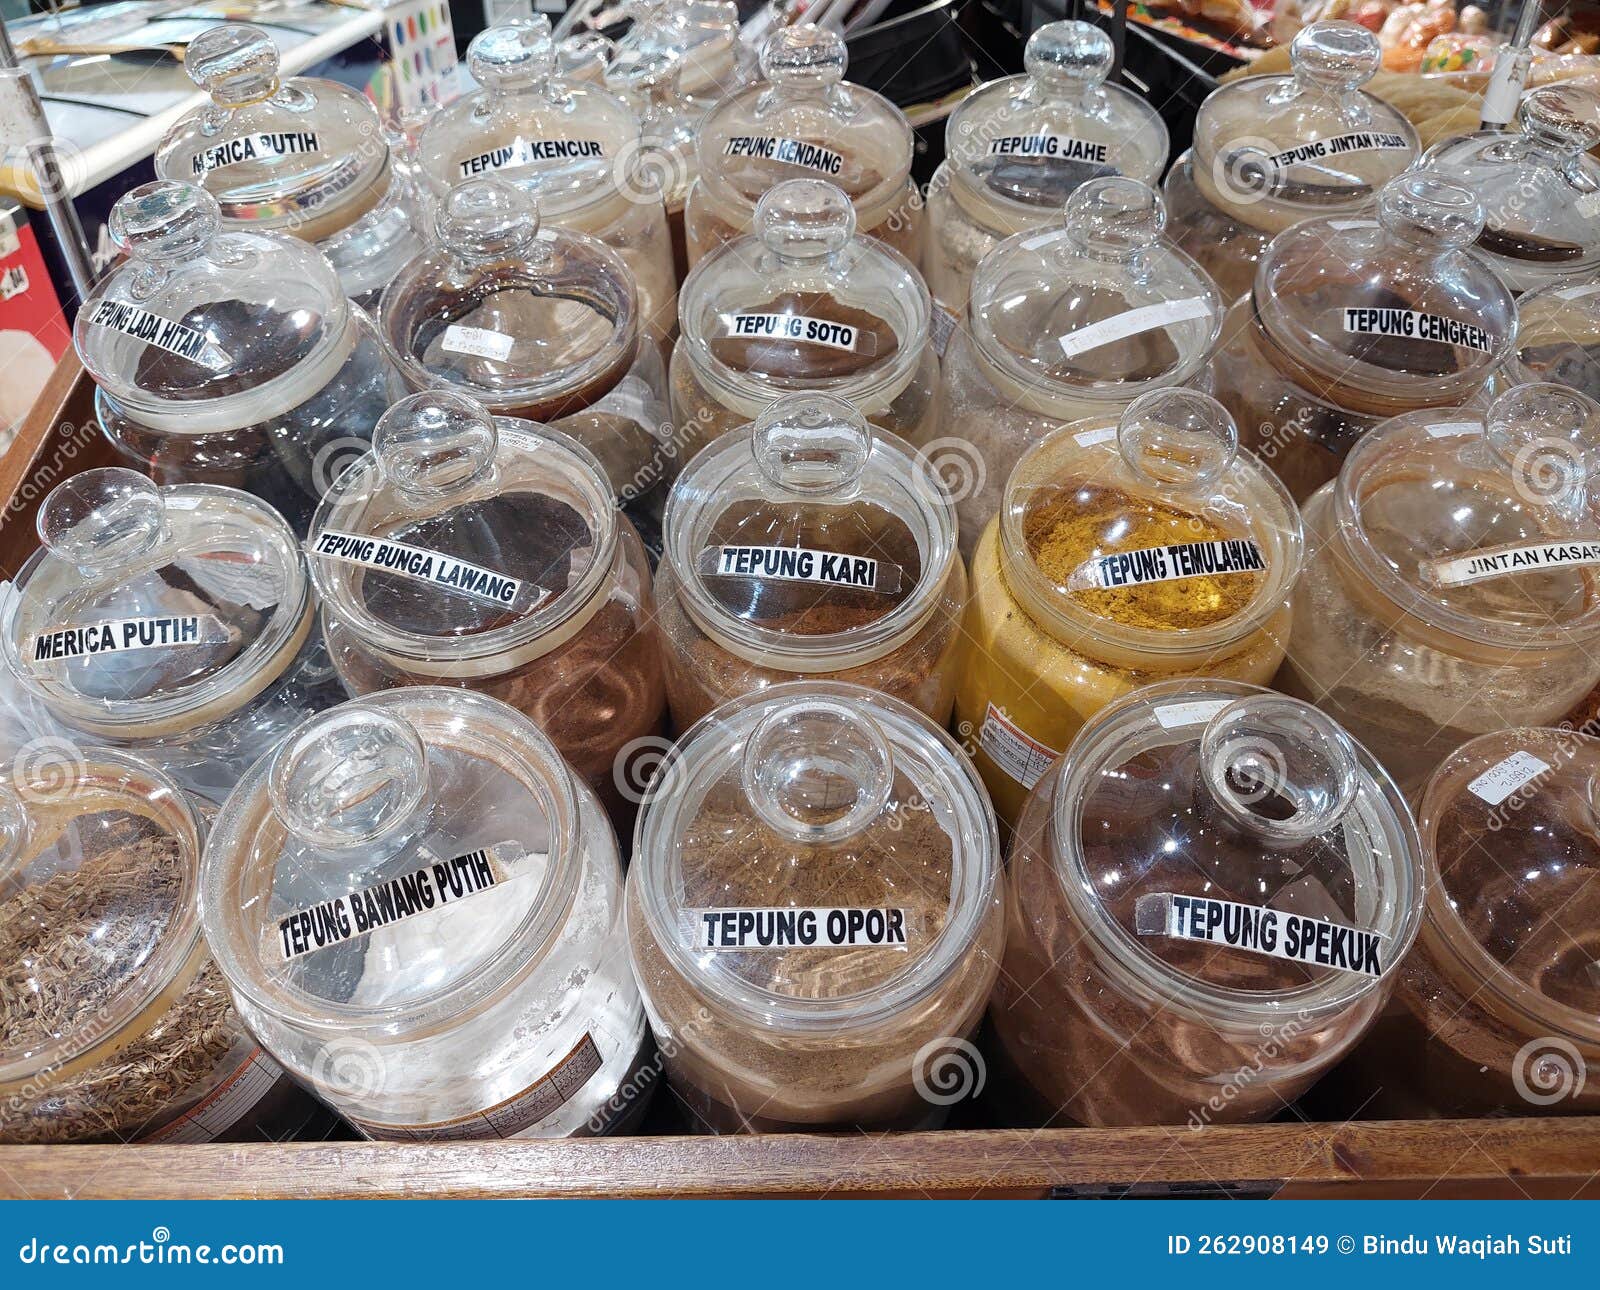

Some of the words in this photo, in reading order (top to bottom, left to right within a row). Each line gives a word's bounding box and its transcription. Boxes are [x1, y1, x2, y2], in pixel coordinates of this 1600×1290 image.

[460, 146, 527, 176] TEPUN
[531, 140, 603, 160] KENCUR
[725, 137, 776, 158] TEPUNG
[777, 139, 842, 175] RENDANG
[991, 136, 1059, 154] TEPUNG
[1063, 139, 1107, 162] JAHE
[1269, 142, 1326, 168] TEPUNG
[1329, 134, 1373, 154] JINTAN
[91, 300, 133, 331] TEPUNG
[127, 310, 162, 343] LADA
[159, 321, 208, 358] HITAM
[806, 321, 852, 345] SOTO
[1347, 309, 1414, 336] TEPUNG
[1418, 313, 1488, 351] CENGKEH
[316, 533, 375, 561] TEPUNG
[373, 544, 433, 578] BUNGA
[435, 560, 516, 602] LAWANG
[723, 548, 813, 578] TEPUNG
[820, 554, 876, 586] KARI
[1099, 547, 1167, 587] TEPUNG
[1468, 549, 1540, 574] JINTAN
[34, 625, 116, 661] MERICA
[123, 617, 198, 648] PUTIH
[279, 898, 352, 958] TEPUNG
[349, 870, 434, 933] BAWANG
[432, 850, 494, 902] PUTIH
[704, 910, 817, 946] TEPUNG
[826, 909, 905, 945] OPOR
[1173, 896, 1278, 952] TEPUNG
[1285, 916, 1382, 976] SPEKUK
